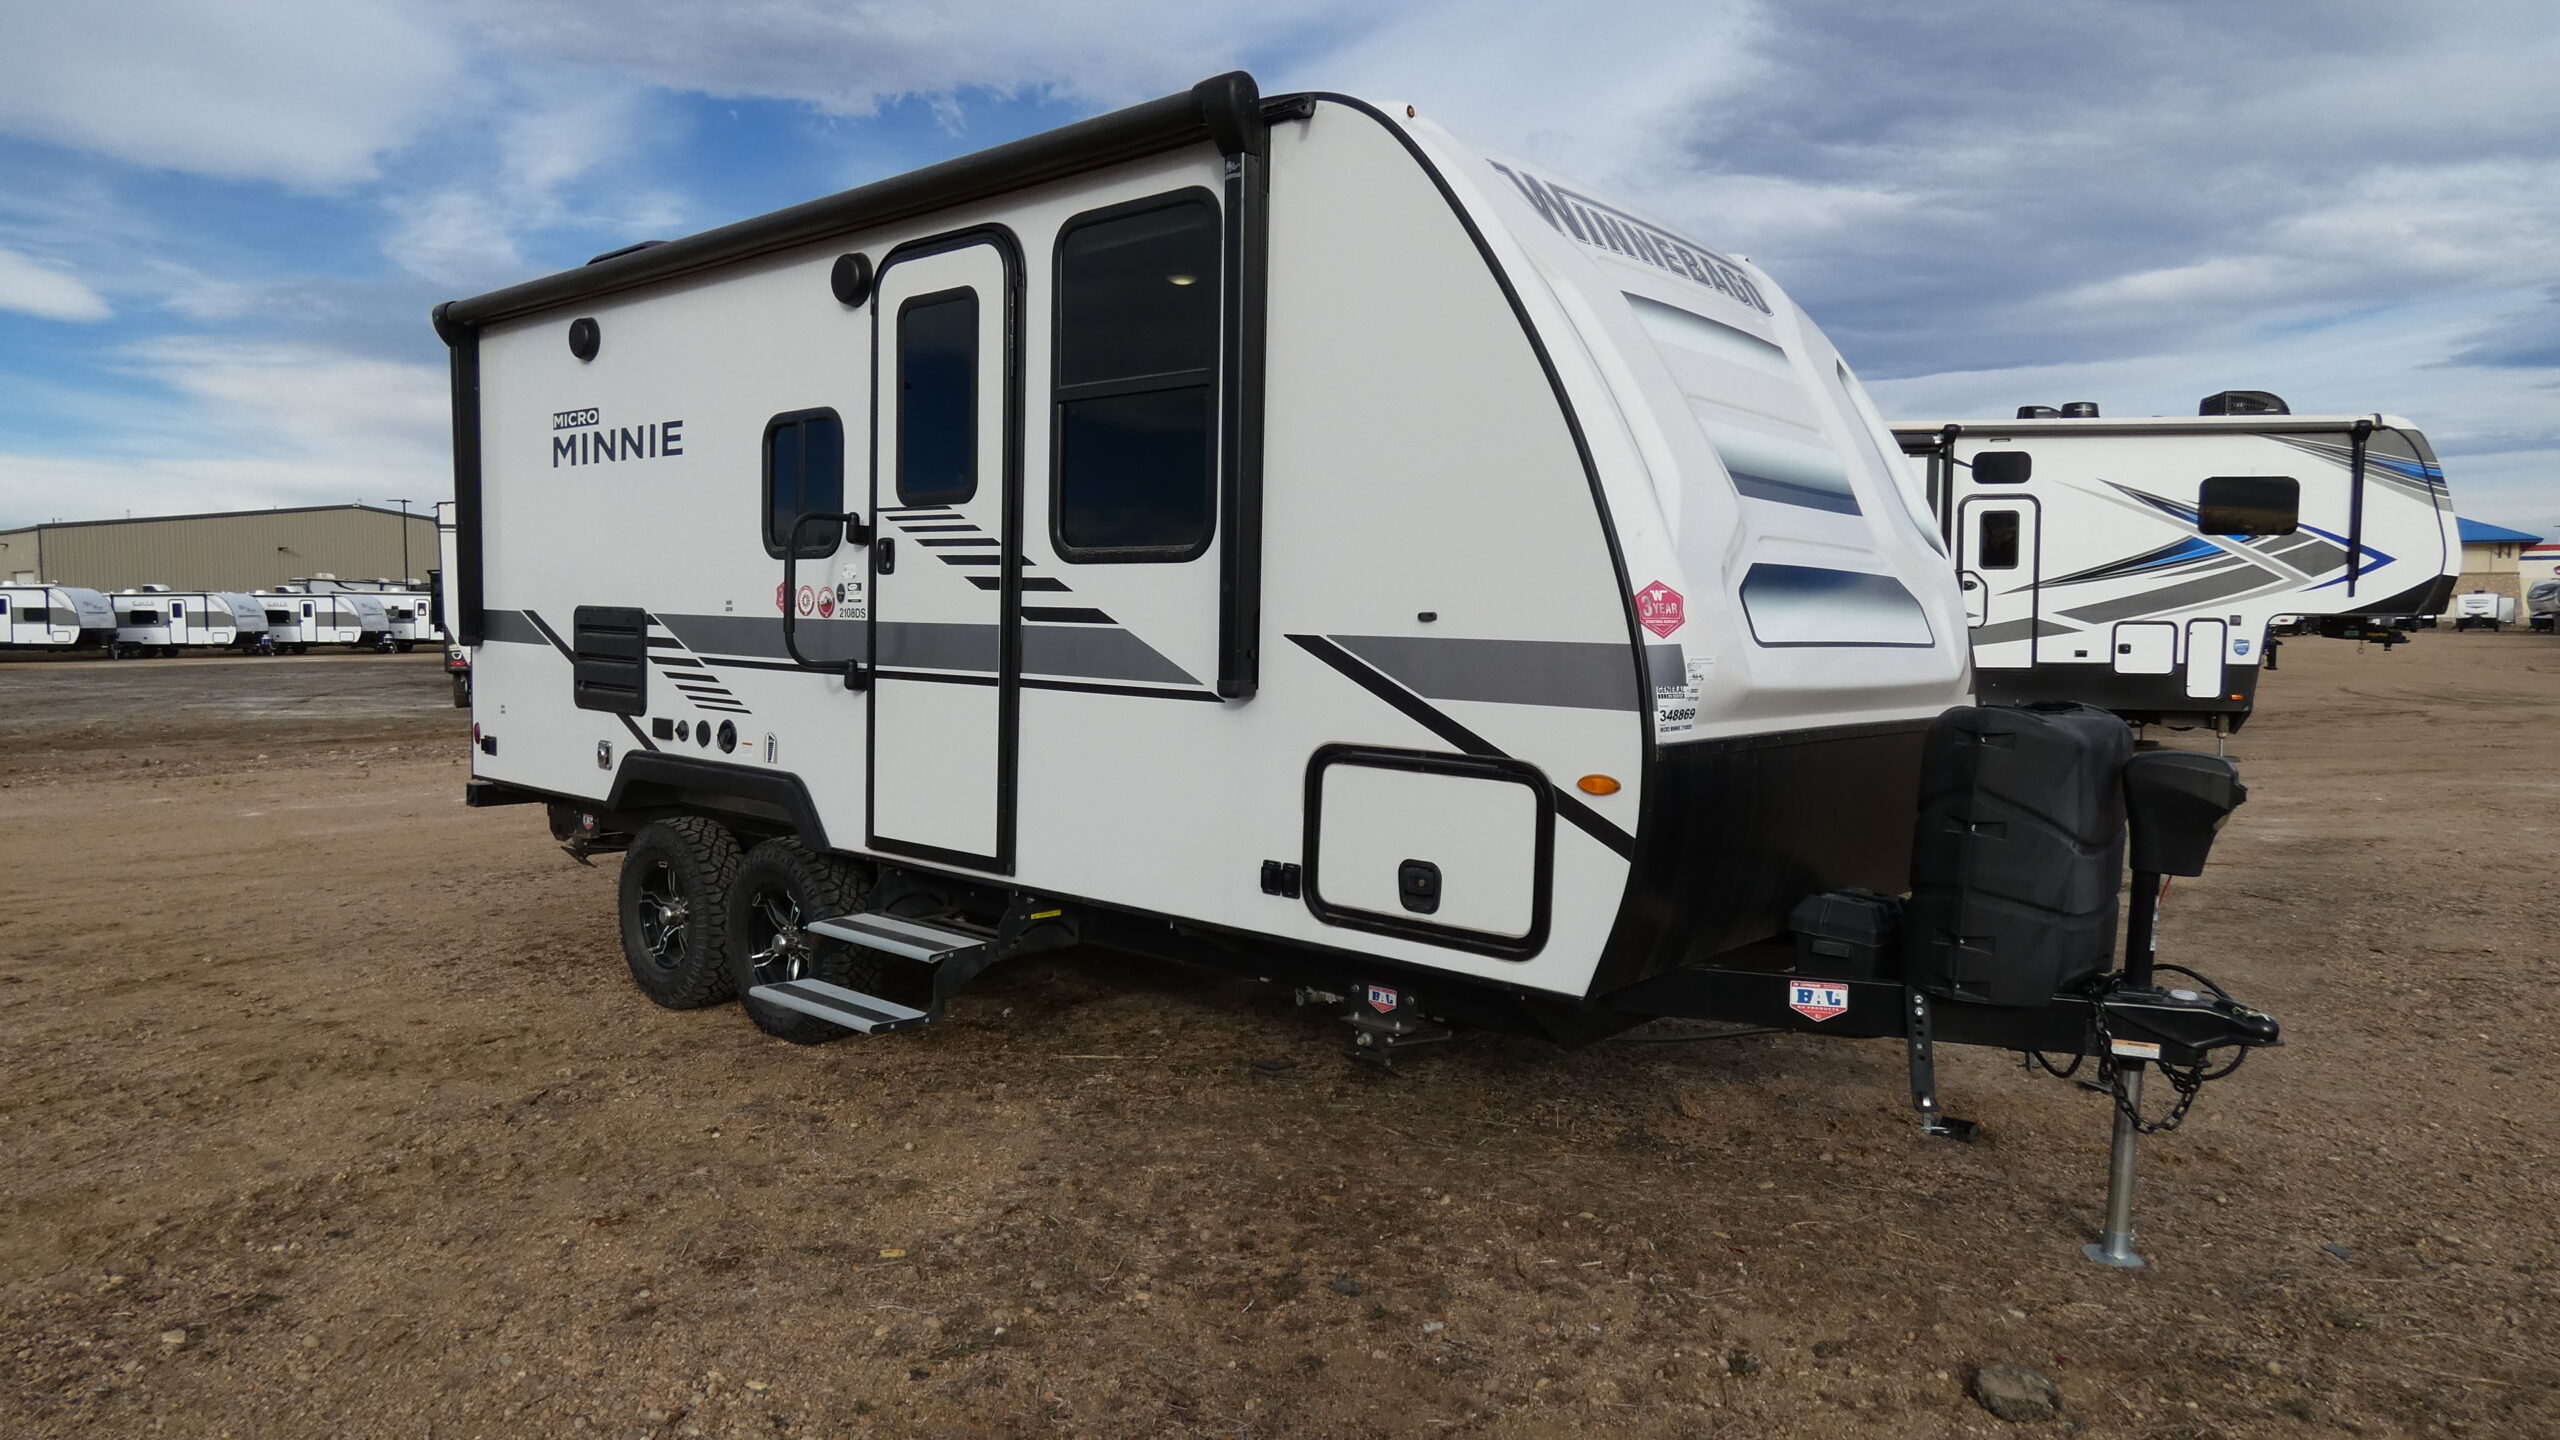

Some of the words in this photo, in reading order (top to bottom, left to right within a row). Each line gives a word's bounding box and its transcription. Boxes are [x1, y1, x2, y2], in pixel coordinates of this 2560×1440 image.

[1486, 157, 1774, 317] WINNEBAGO
[554, 409, 599, 429] MICRO
[553, 420, 683, 468] MINNIE
[839, 607, 866, 619] 2108DS
[1652, 602, 1678, 615] YEAR
[1659, 708, 1696, 722] 348869
[1797, 989, 1841, 1006] BAL
